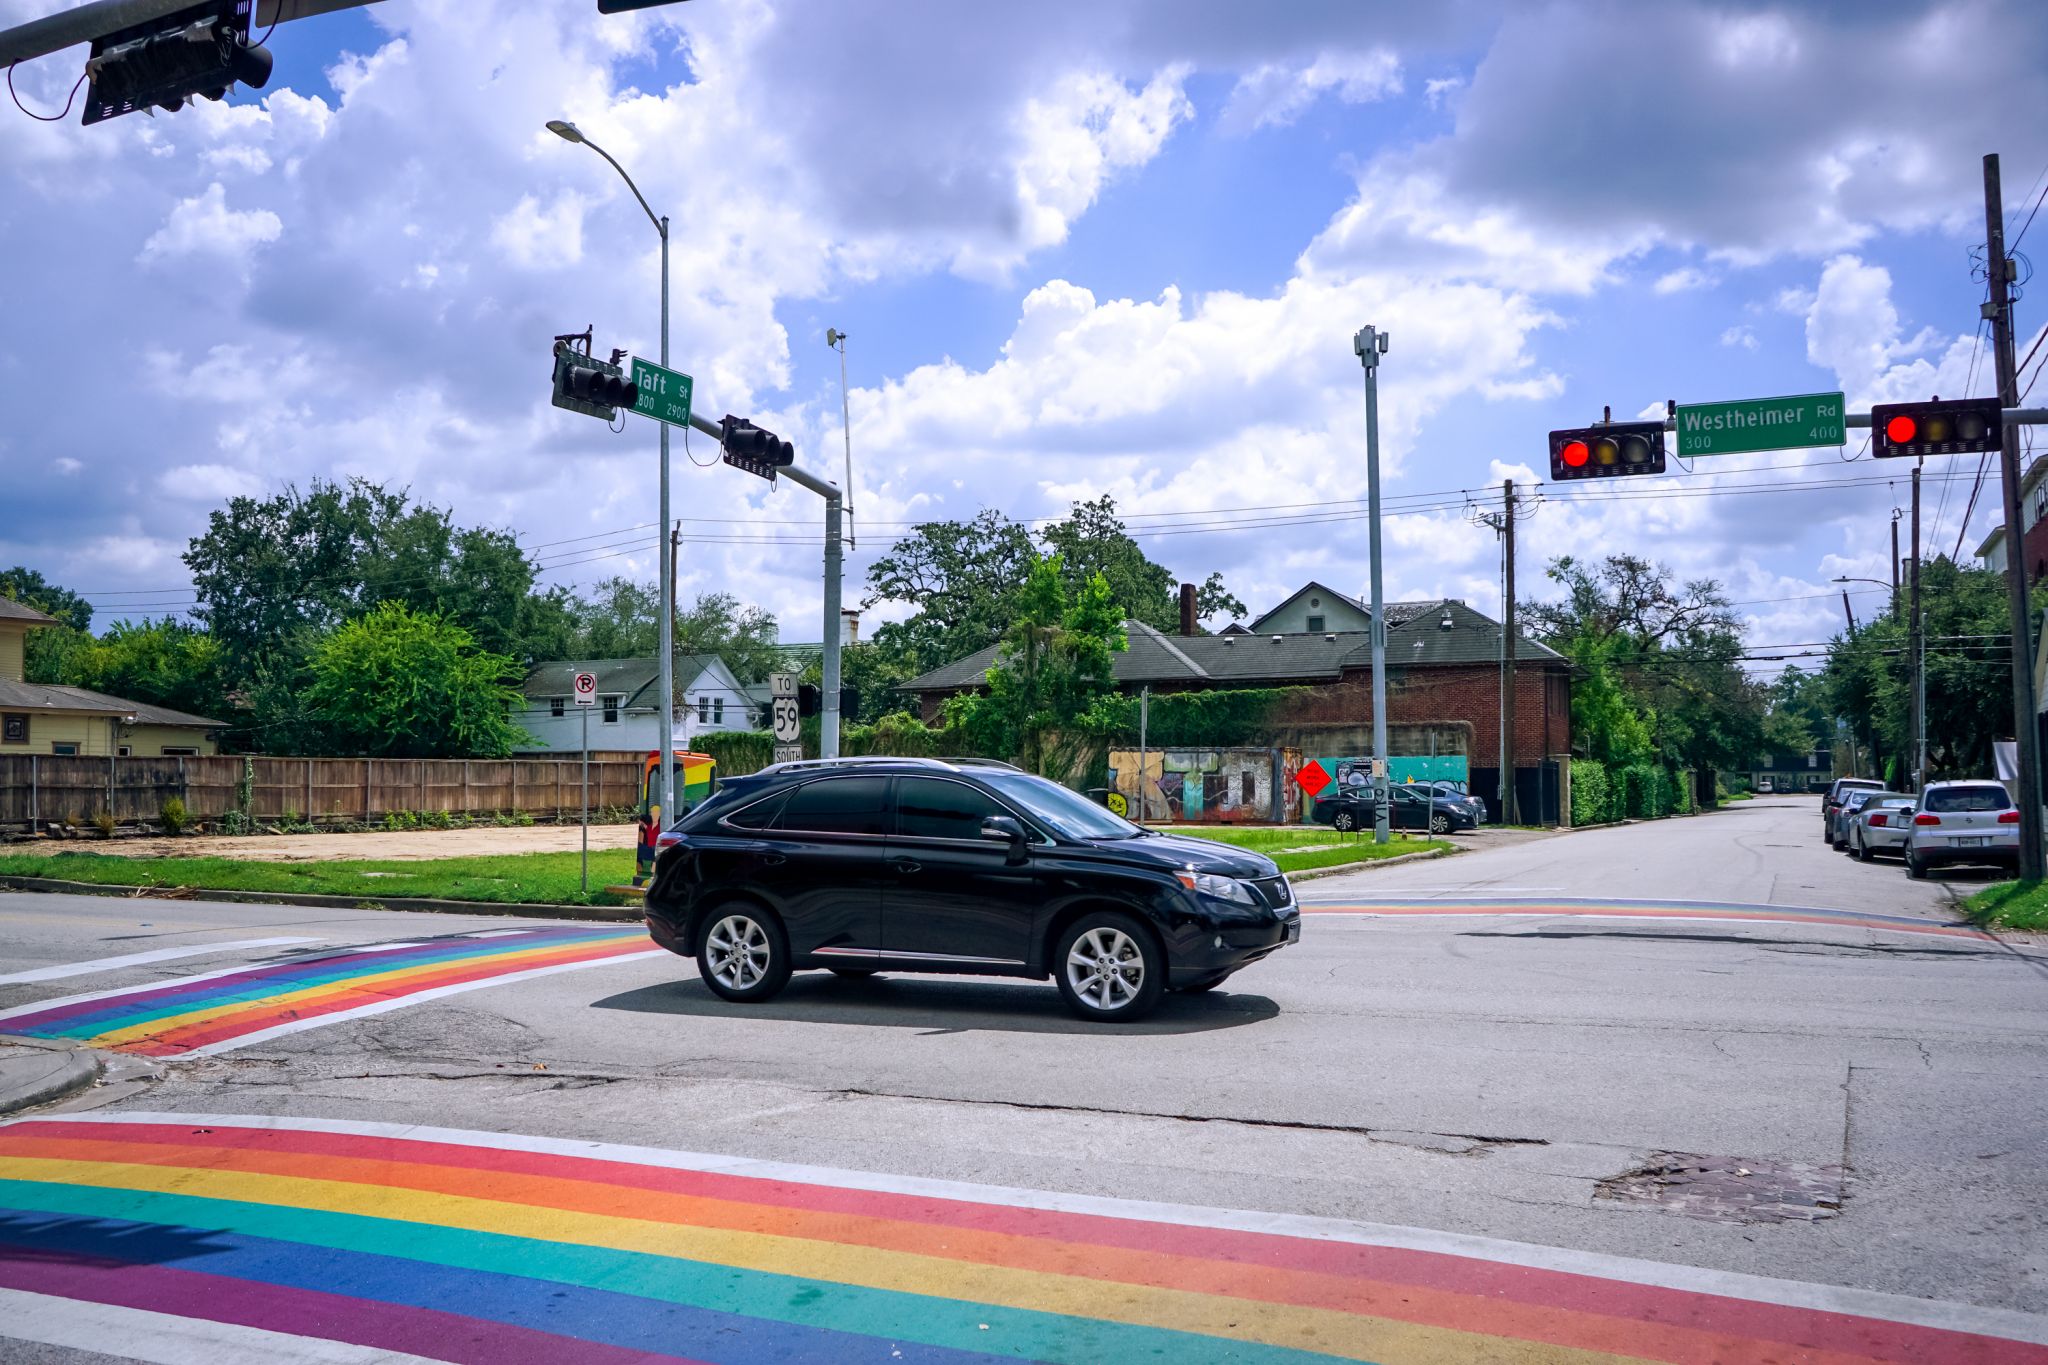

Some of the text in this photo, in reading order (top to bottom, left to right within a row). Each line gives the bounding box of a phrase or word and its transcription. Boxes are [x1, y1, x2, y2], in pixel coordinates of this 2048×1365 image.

[636, 366, 689, 399] Taft St
[635, 393, 687, 420] 800 2900
[1684, 405, 1836, 432] Westheimer Rd
[1685, 425, 1838, 449] 300 400
[777, 678, 791, 691] TO
[776, 707, 797, 732] 59
[776, 750, 801, 763] SOUTH
